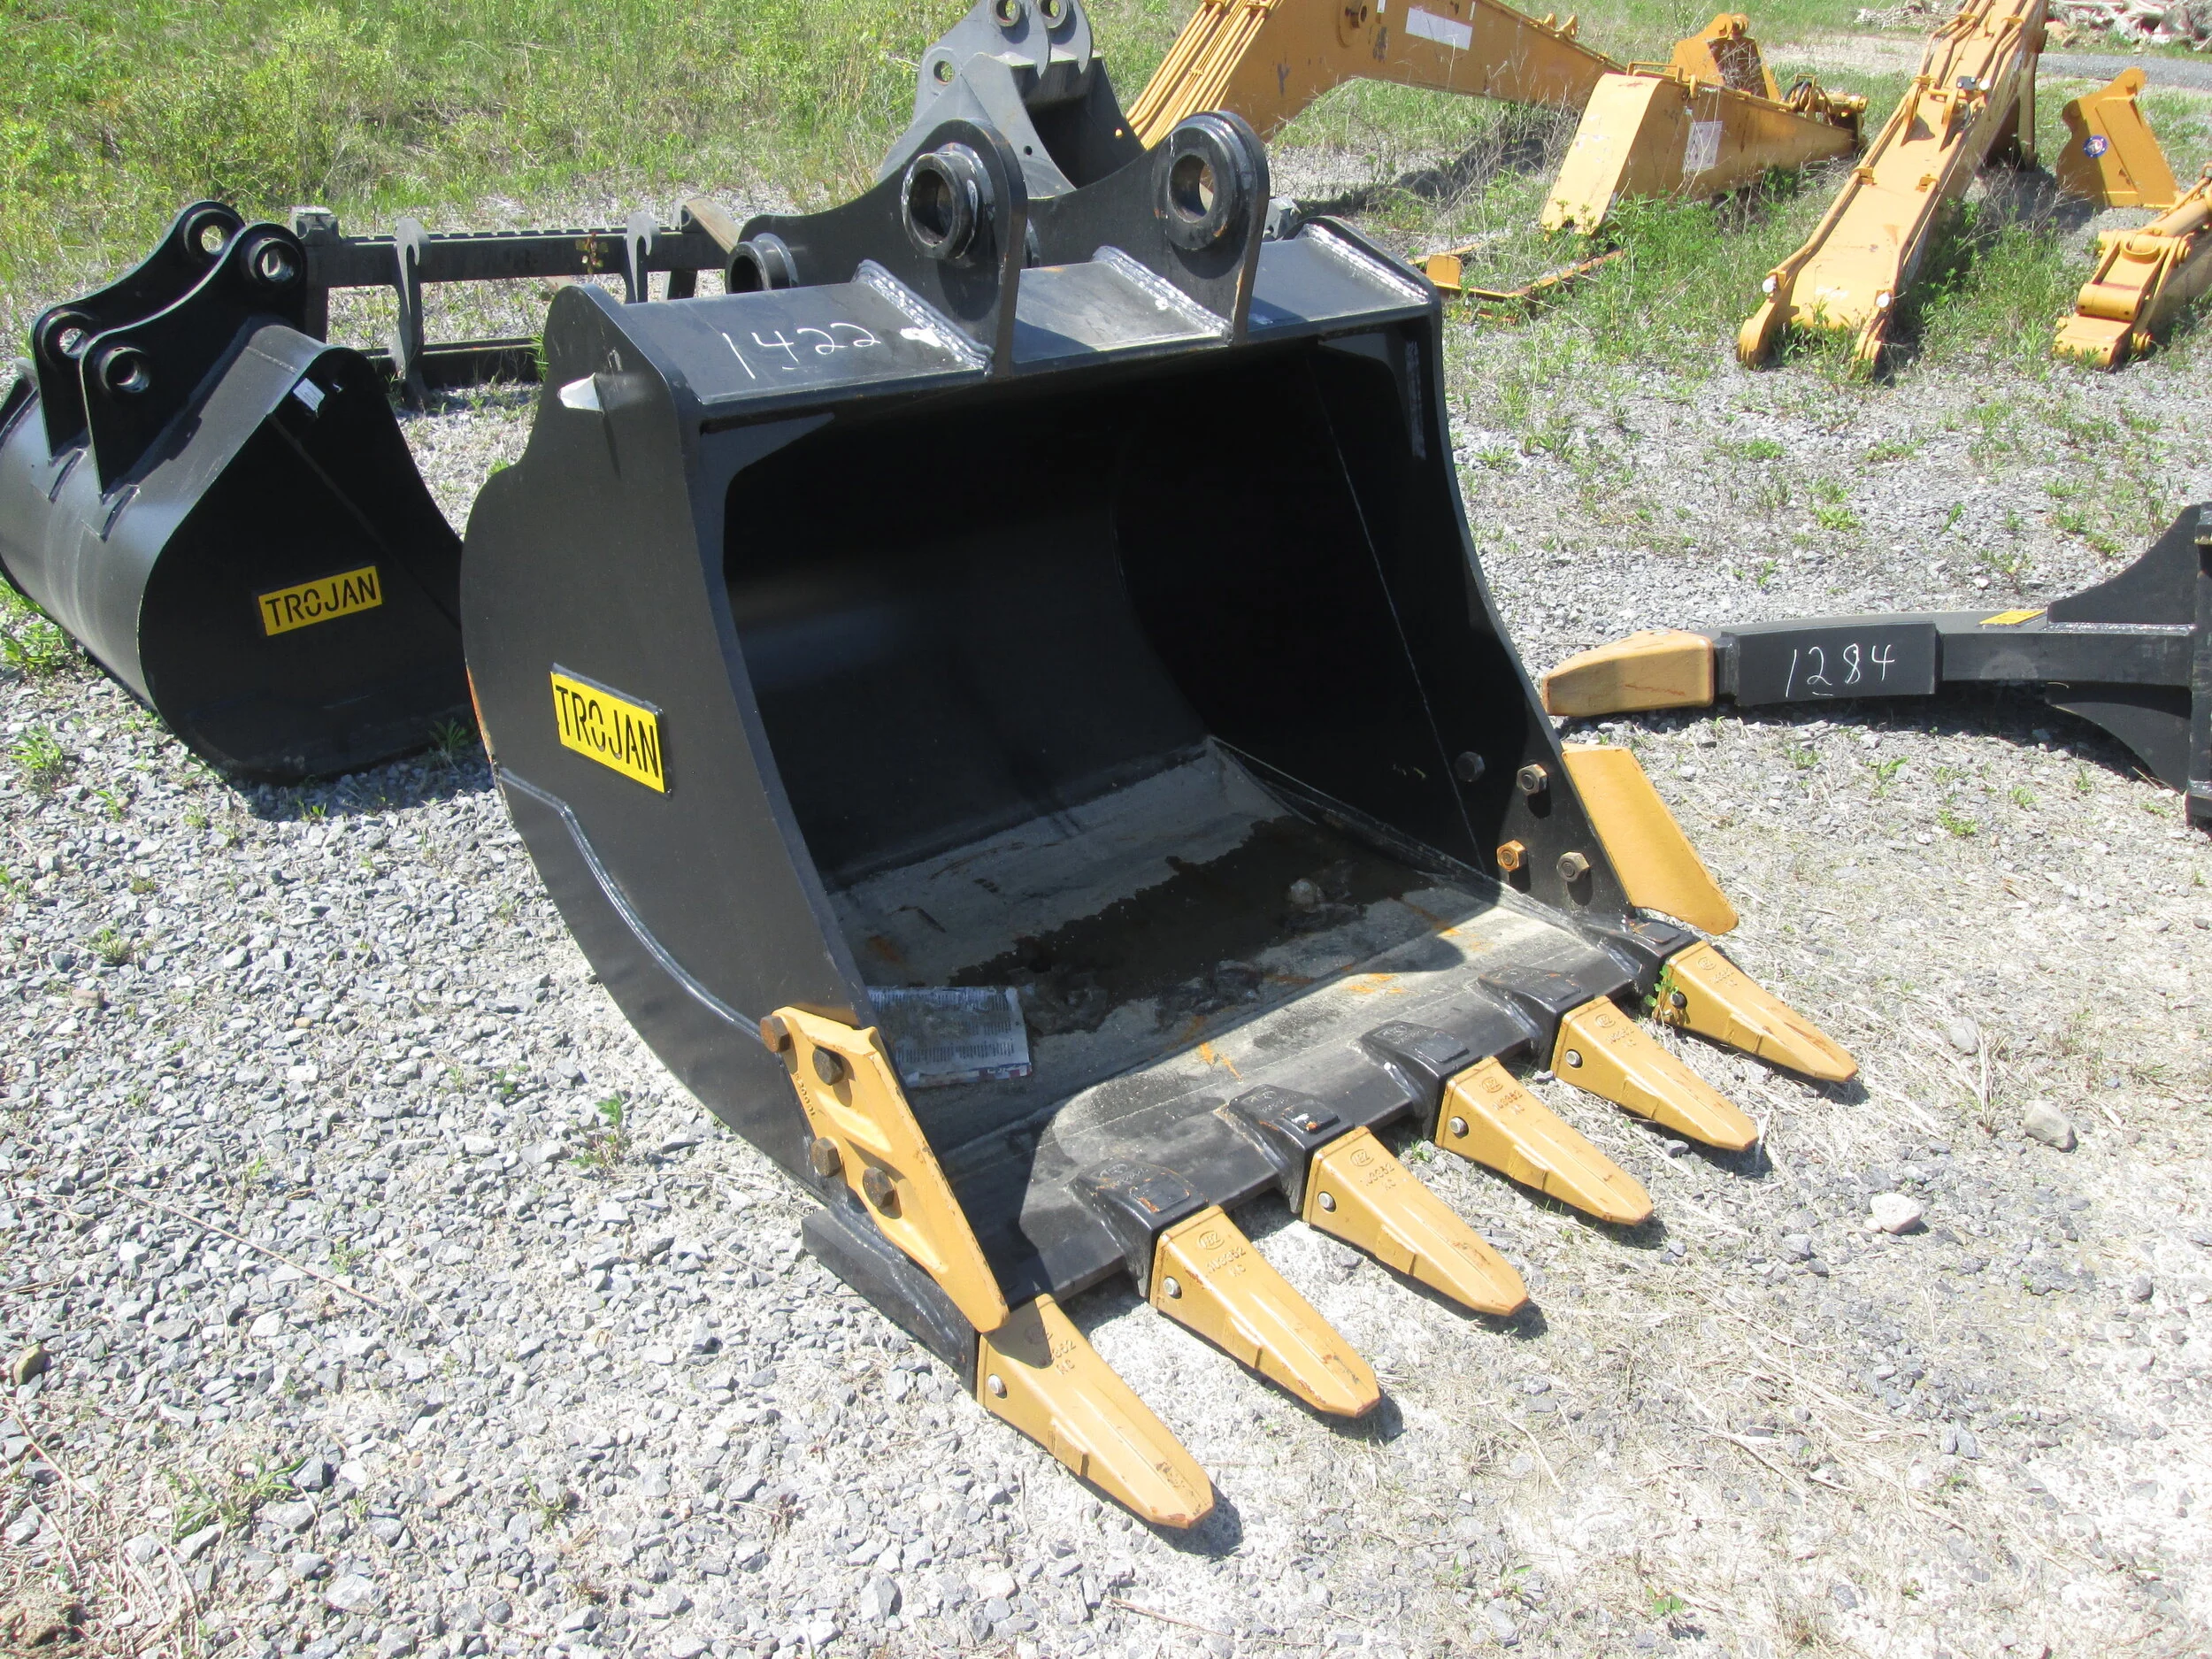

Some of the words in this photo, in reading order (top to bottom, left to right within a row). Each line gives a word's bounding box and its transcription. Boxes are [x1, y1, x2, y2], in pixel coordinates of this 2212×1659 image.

[722, 322, 881, 380] 1422
[265, 573, 377, 627] TROJAN
[1786, 643, 1895, 697] 1284
[555, 685, 659, 779] TROJAN
